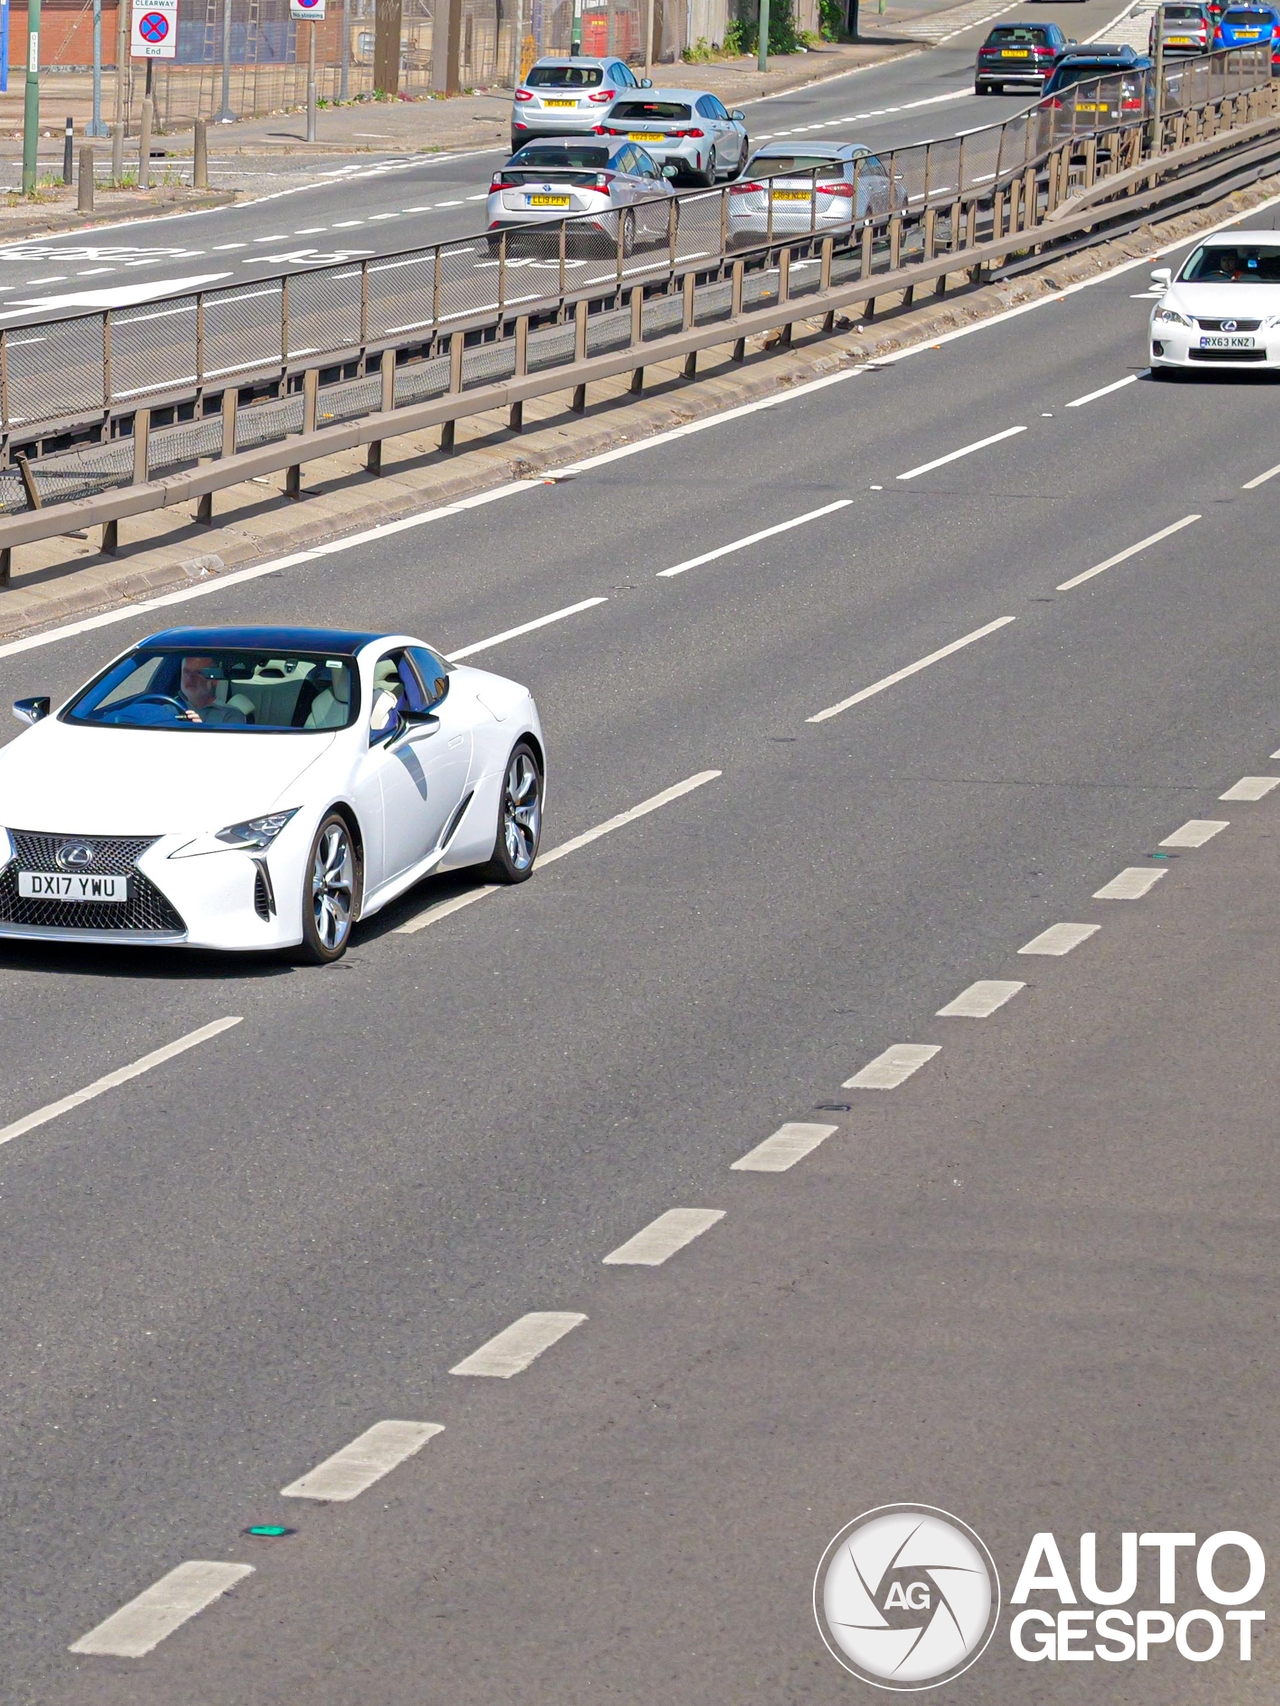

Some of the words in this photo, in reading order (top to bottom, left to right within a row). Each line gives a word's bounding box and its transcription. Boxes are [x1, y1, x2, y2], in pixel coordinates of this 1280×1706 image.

[145, 47, 161, 55] End
[532, 195, 549, 204] LL19
[551, 196, 567, 204] PFN
[1205, 337, 1229, 347] RX63
[1231, 338, 1250, 347] KNZ
[31, 875, 73, 895] DX17
[78, 877, 115, 897] YWU
